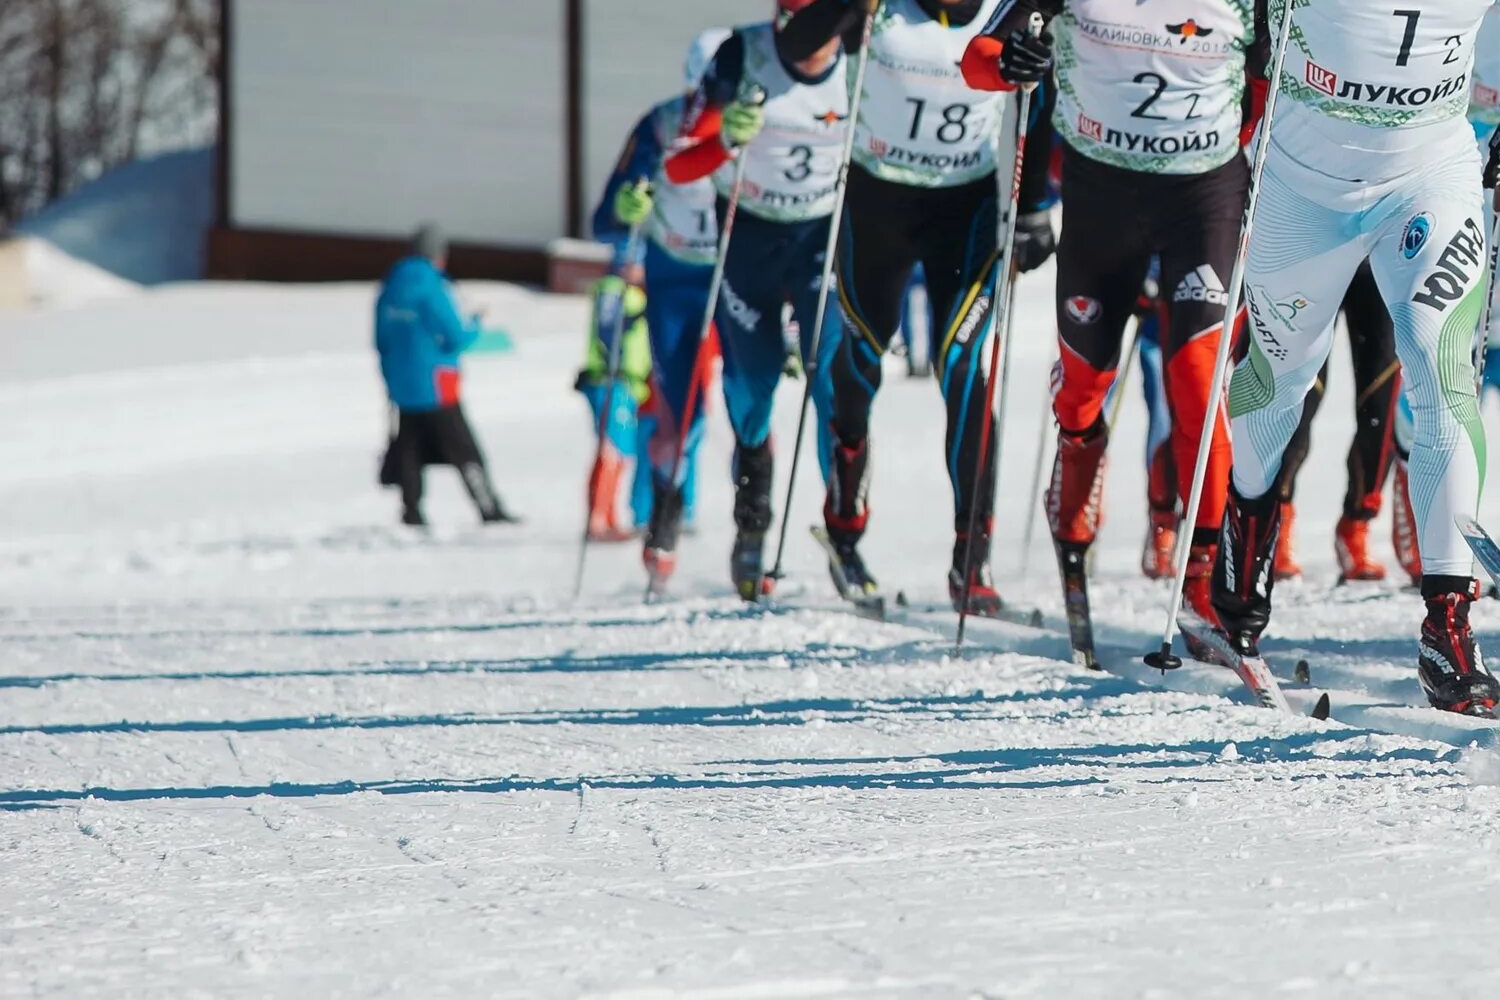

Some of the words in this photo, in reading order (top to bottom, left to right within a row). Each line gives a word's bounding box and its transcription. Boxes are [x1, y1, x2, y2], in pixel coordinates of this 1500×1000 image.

[1080, 23, 1173, 48] МАЛИНОВКА
[1130, 72, 1168, 121] 2
[1337, 74, 1466, 106] ЛУКОЙЛ
[906, 96, 970, 144] 18
[1105, 130, 1220, 155] ЛУКОЙЛ
[784, 144, 813, 183] 3
